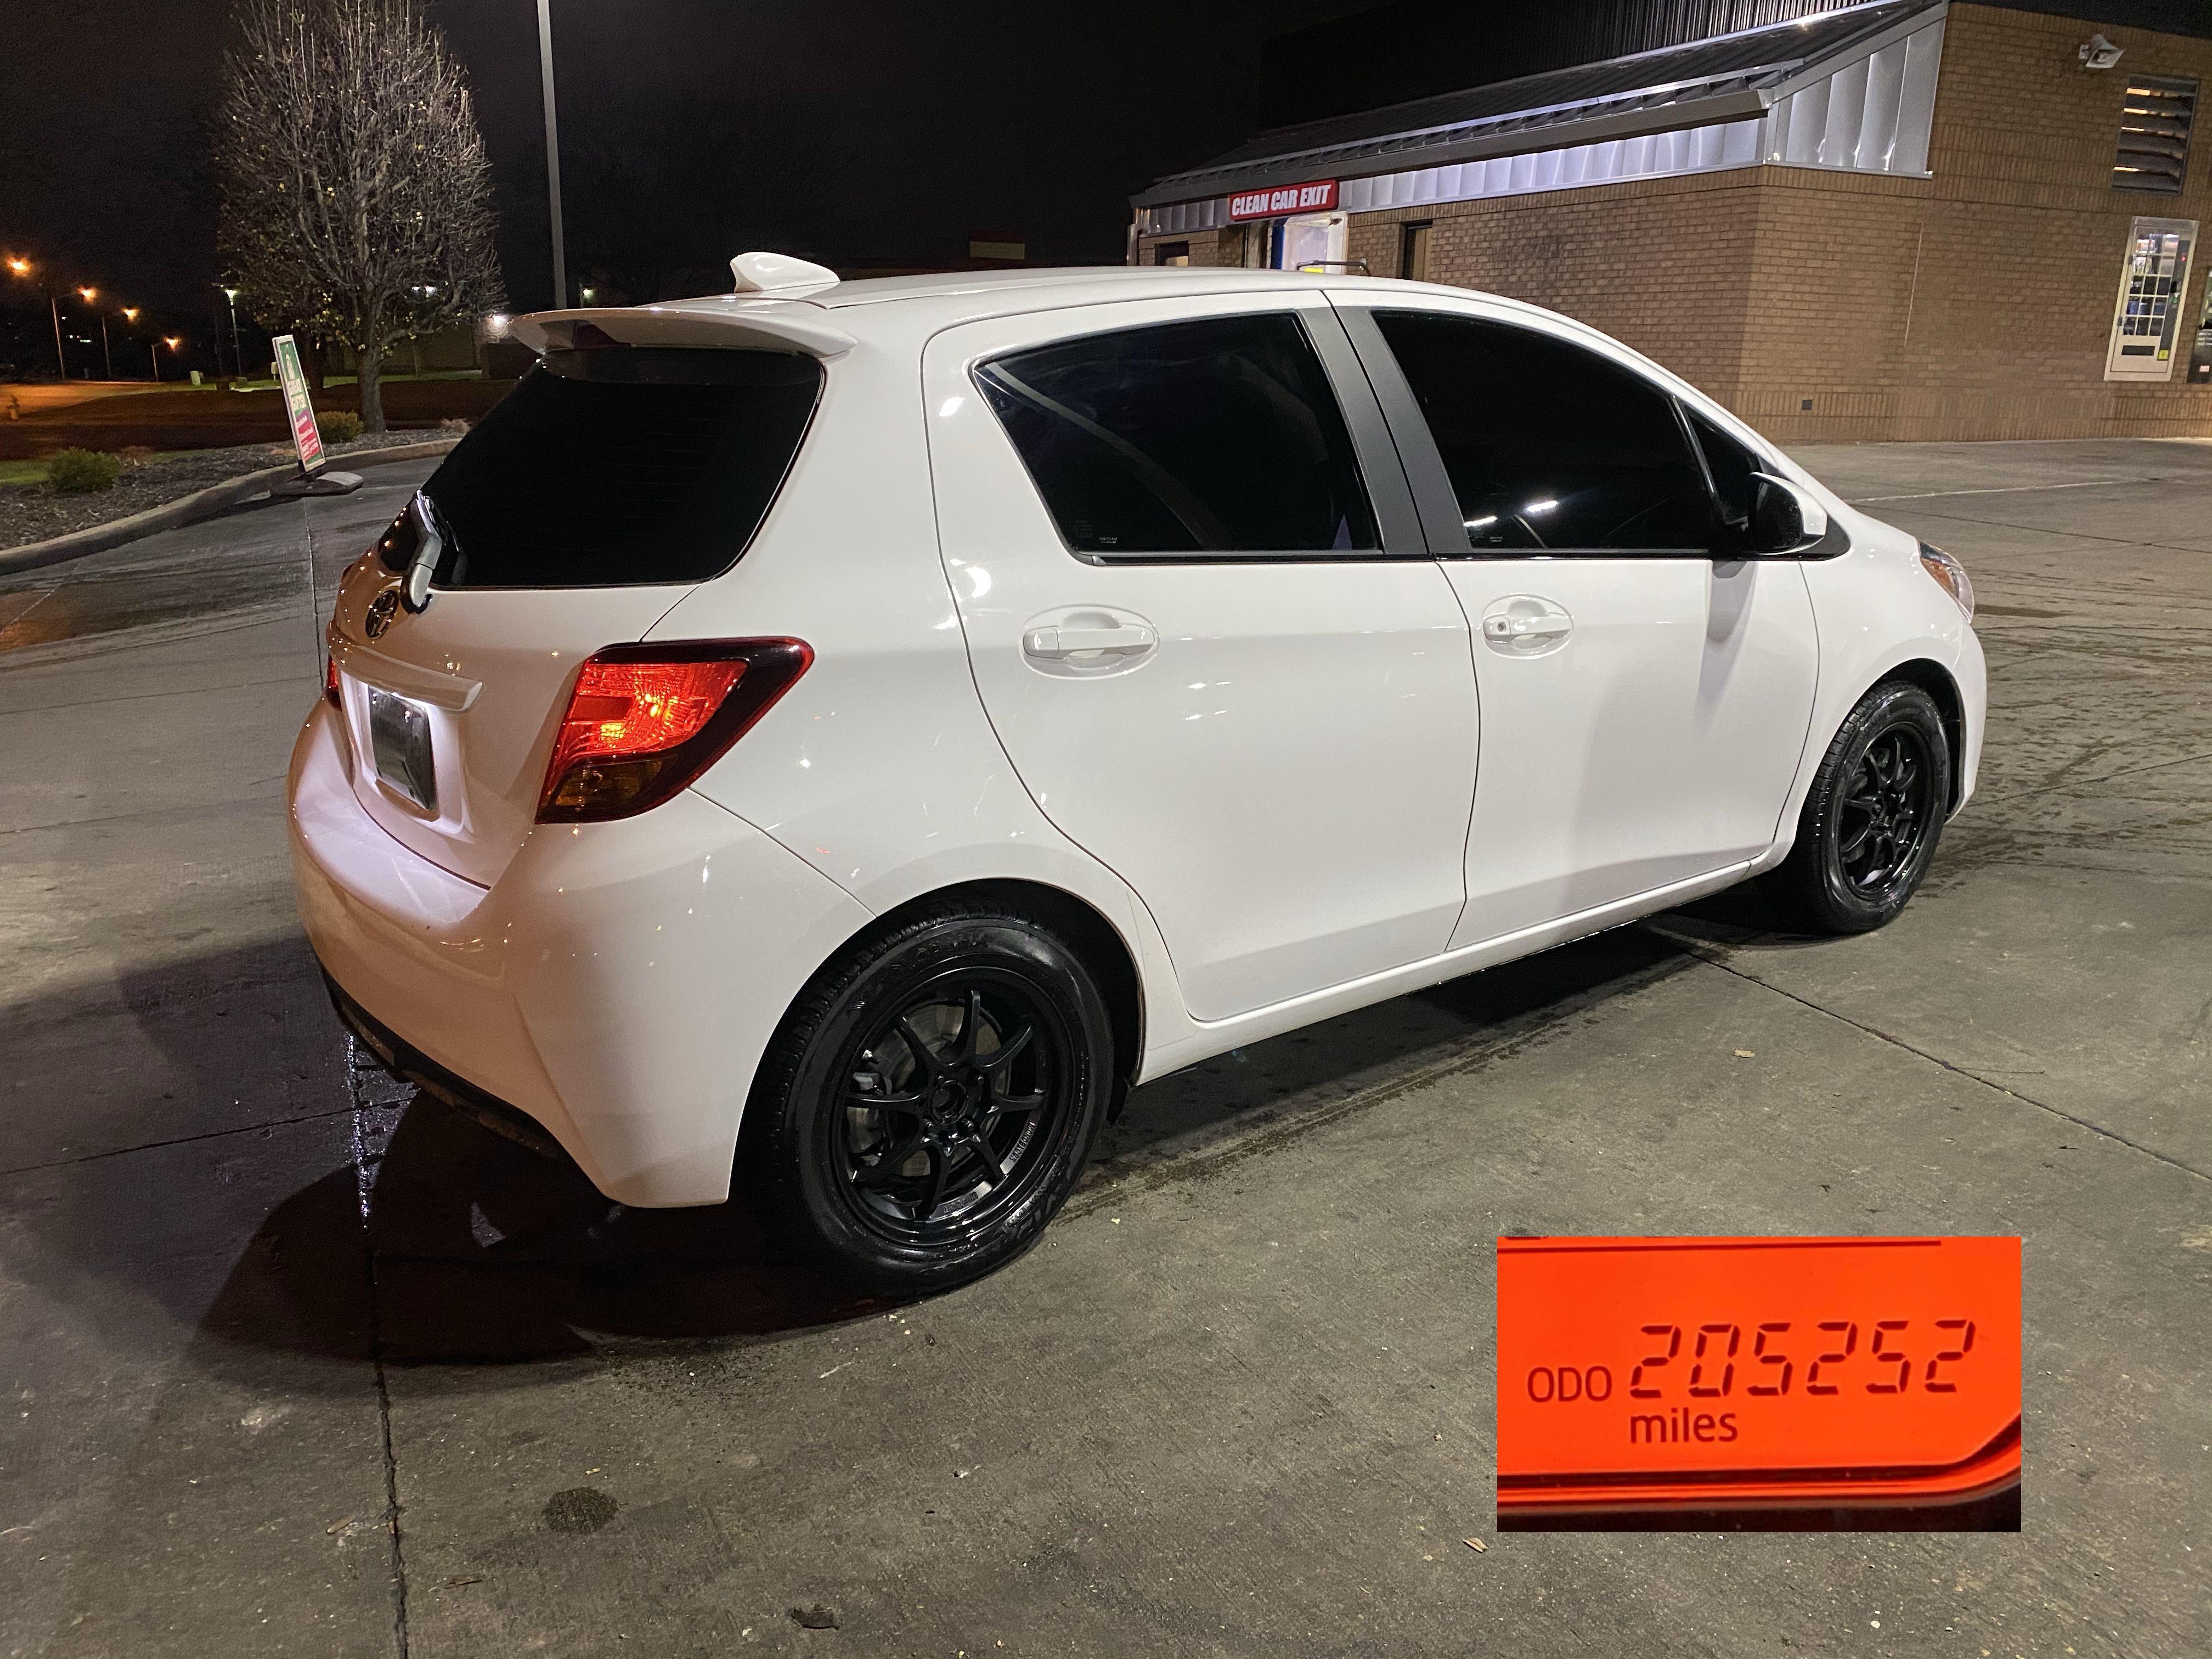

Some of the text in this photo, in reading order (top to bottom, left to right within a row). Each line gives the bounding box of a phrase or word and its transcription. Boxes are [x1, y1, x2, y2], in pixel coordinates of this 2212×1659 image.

[1232, 184, 1331, 216] CLEAN CAR EXIT
[1527, 1319, 1976, 1403] ODO 205252
[1630, 1407, 1738, 1443] miles
